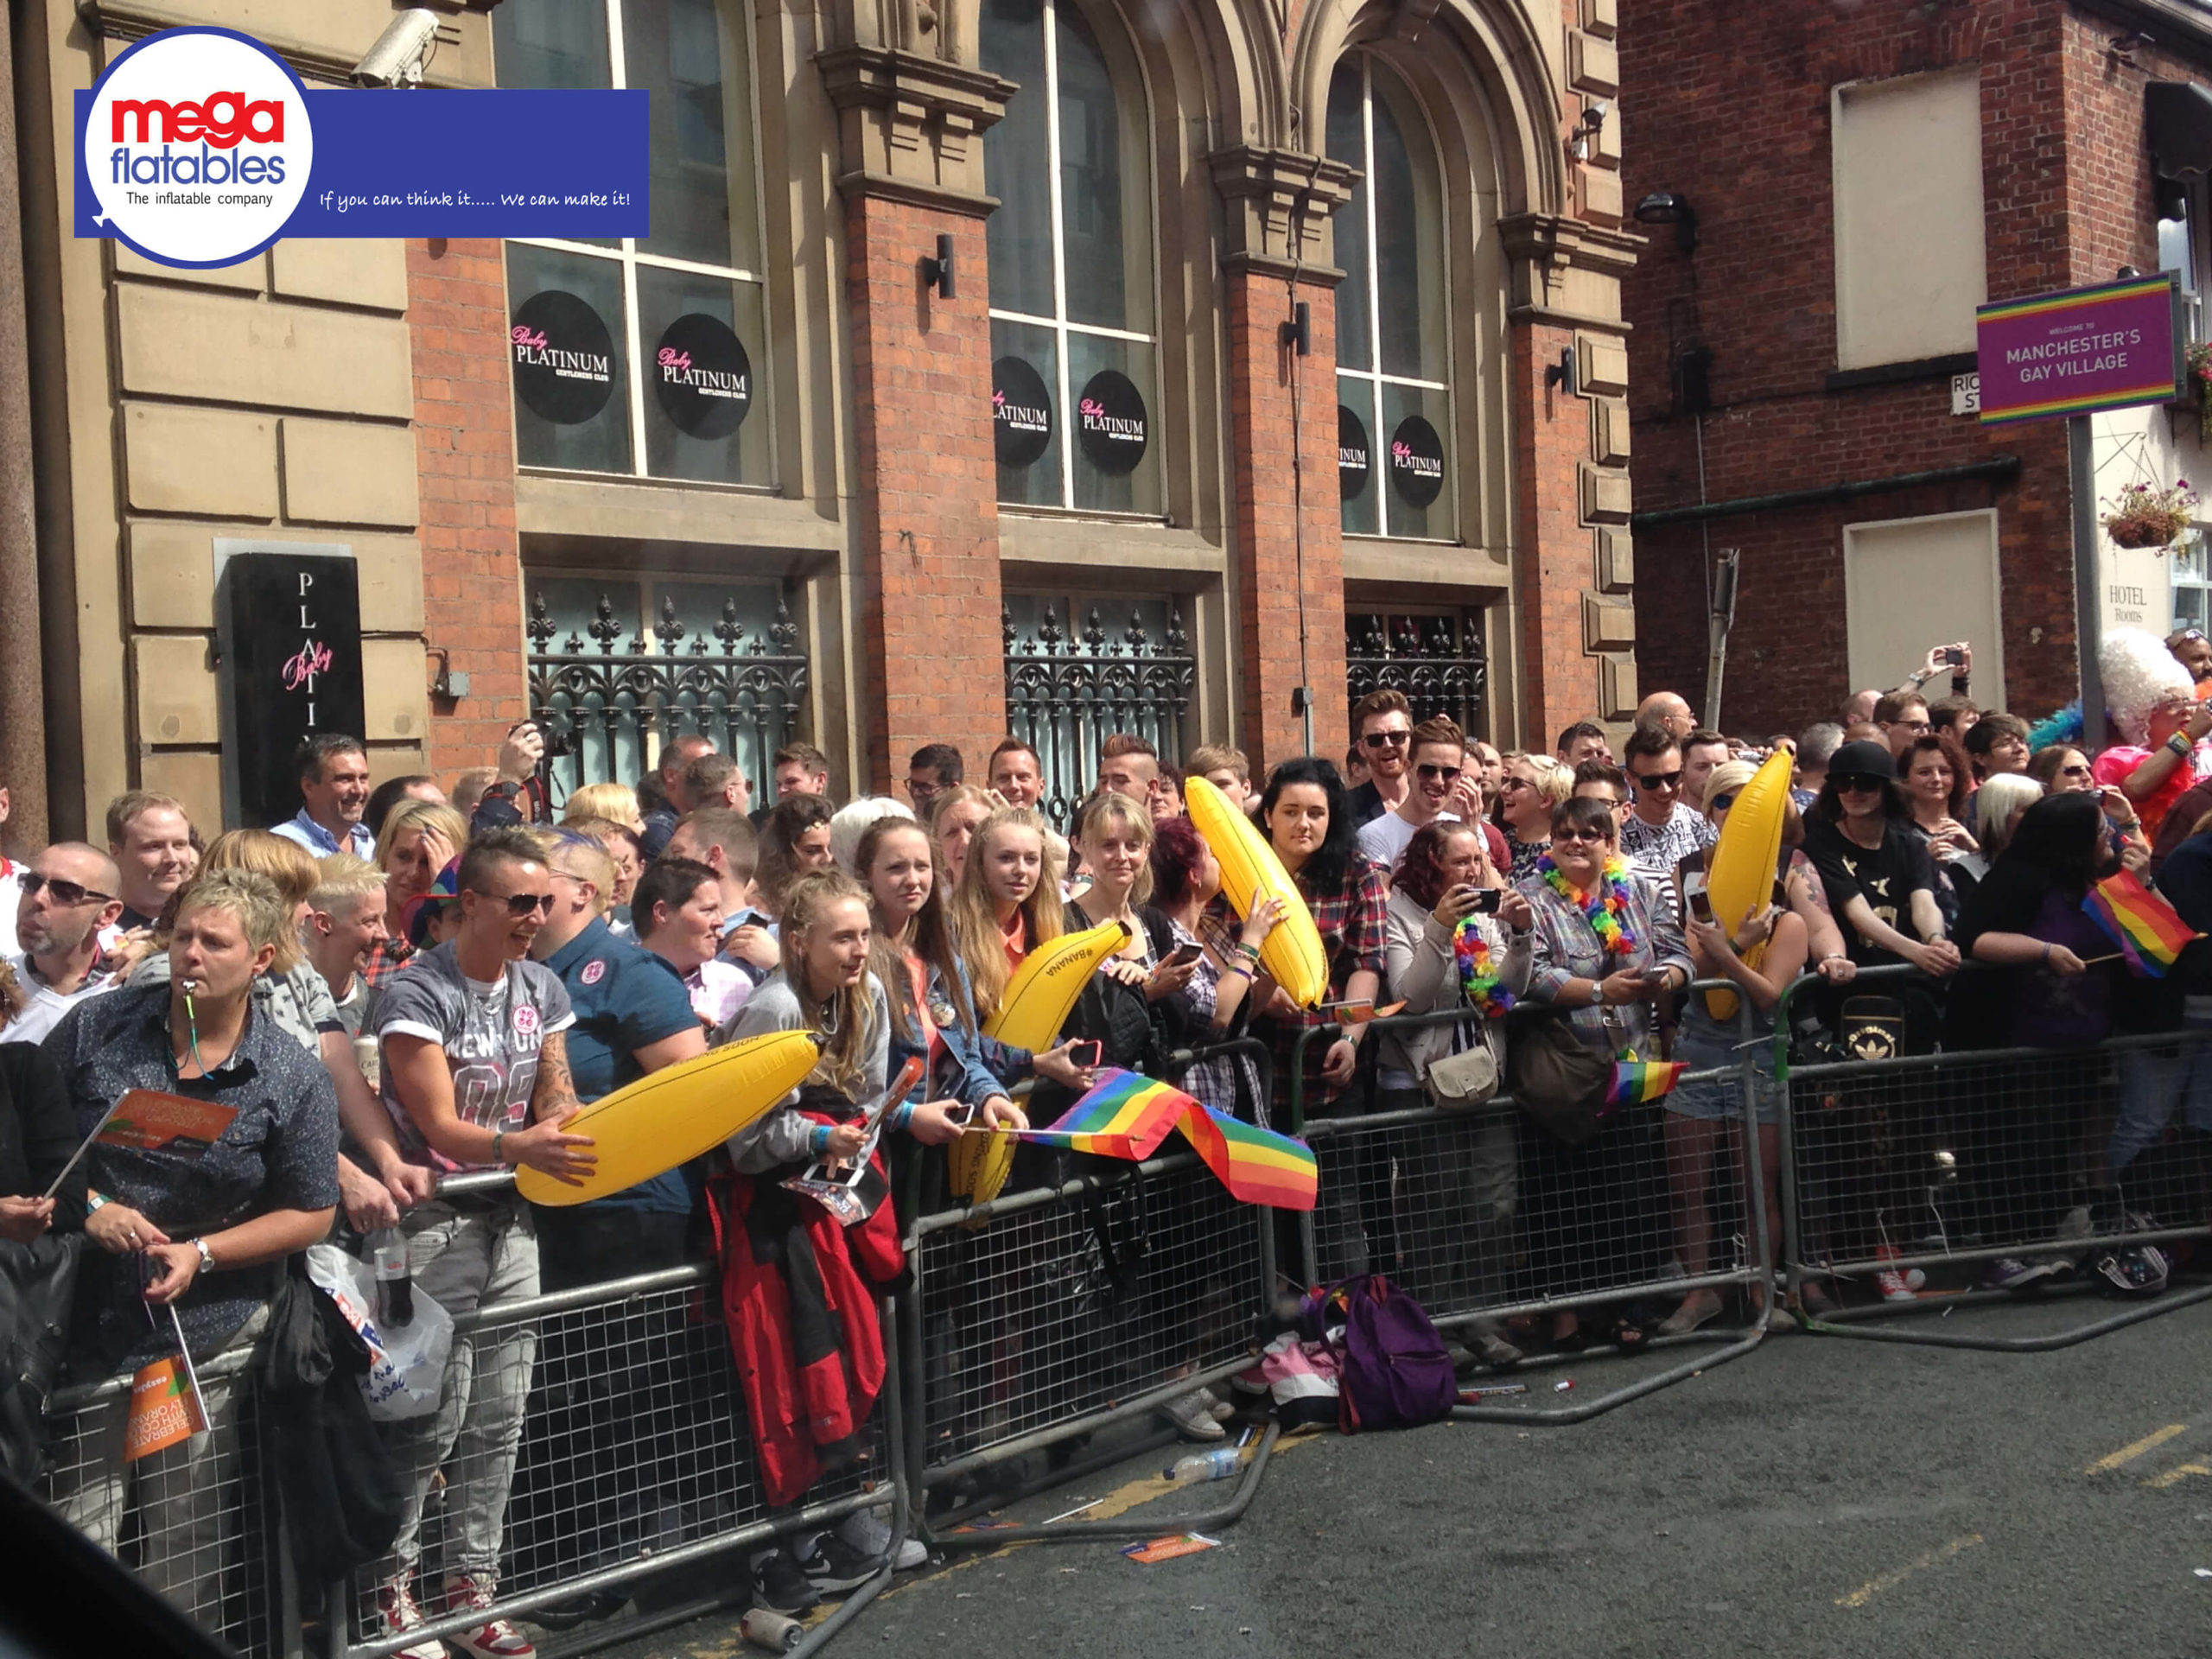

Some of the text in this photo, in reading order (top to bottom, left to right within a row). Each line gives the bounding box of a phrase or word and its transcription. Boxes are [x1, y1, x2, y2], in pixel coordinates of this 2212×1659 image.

[510, 326, 547, 351] Baby
[2049, 323, 2083, 335] WELCOME
[2006, 329, 2141, 364] MANCHESTER'S
[517, 345, 608, 373] PLATINUM
[658, 347, 691, 371] Baby
[2020, 353, 2128, 383] GAY VILLAGE
[663, 365, 746, 391] PLATINUM
[1955, 375, 1980, 391] RIC
[993, 404, 1047, 425] ATINUM
[1084, 414, 1143, 435] PLATINUM
[1395, 454, 1441, 472] PLATINUM
[2109, 585, 2147, 606] HOTEL
[283, 641, 333, 690] Baby
[298, 572, 318, 747] PLATI
